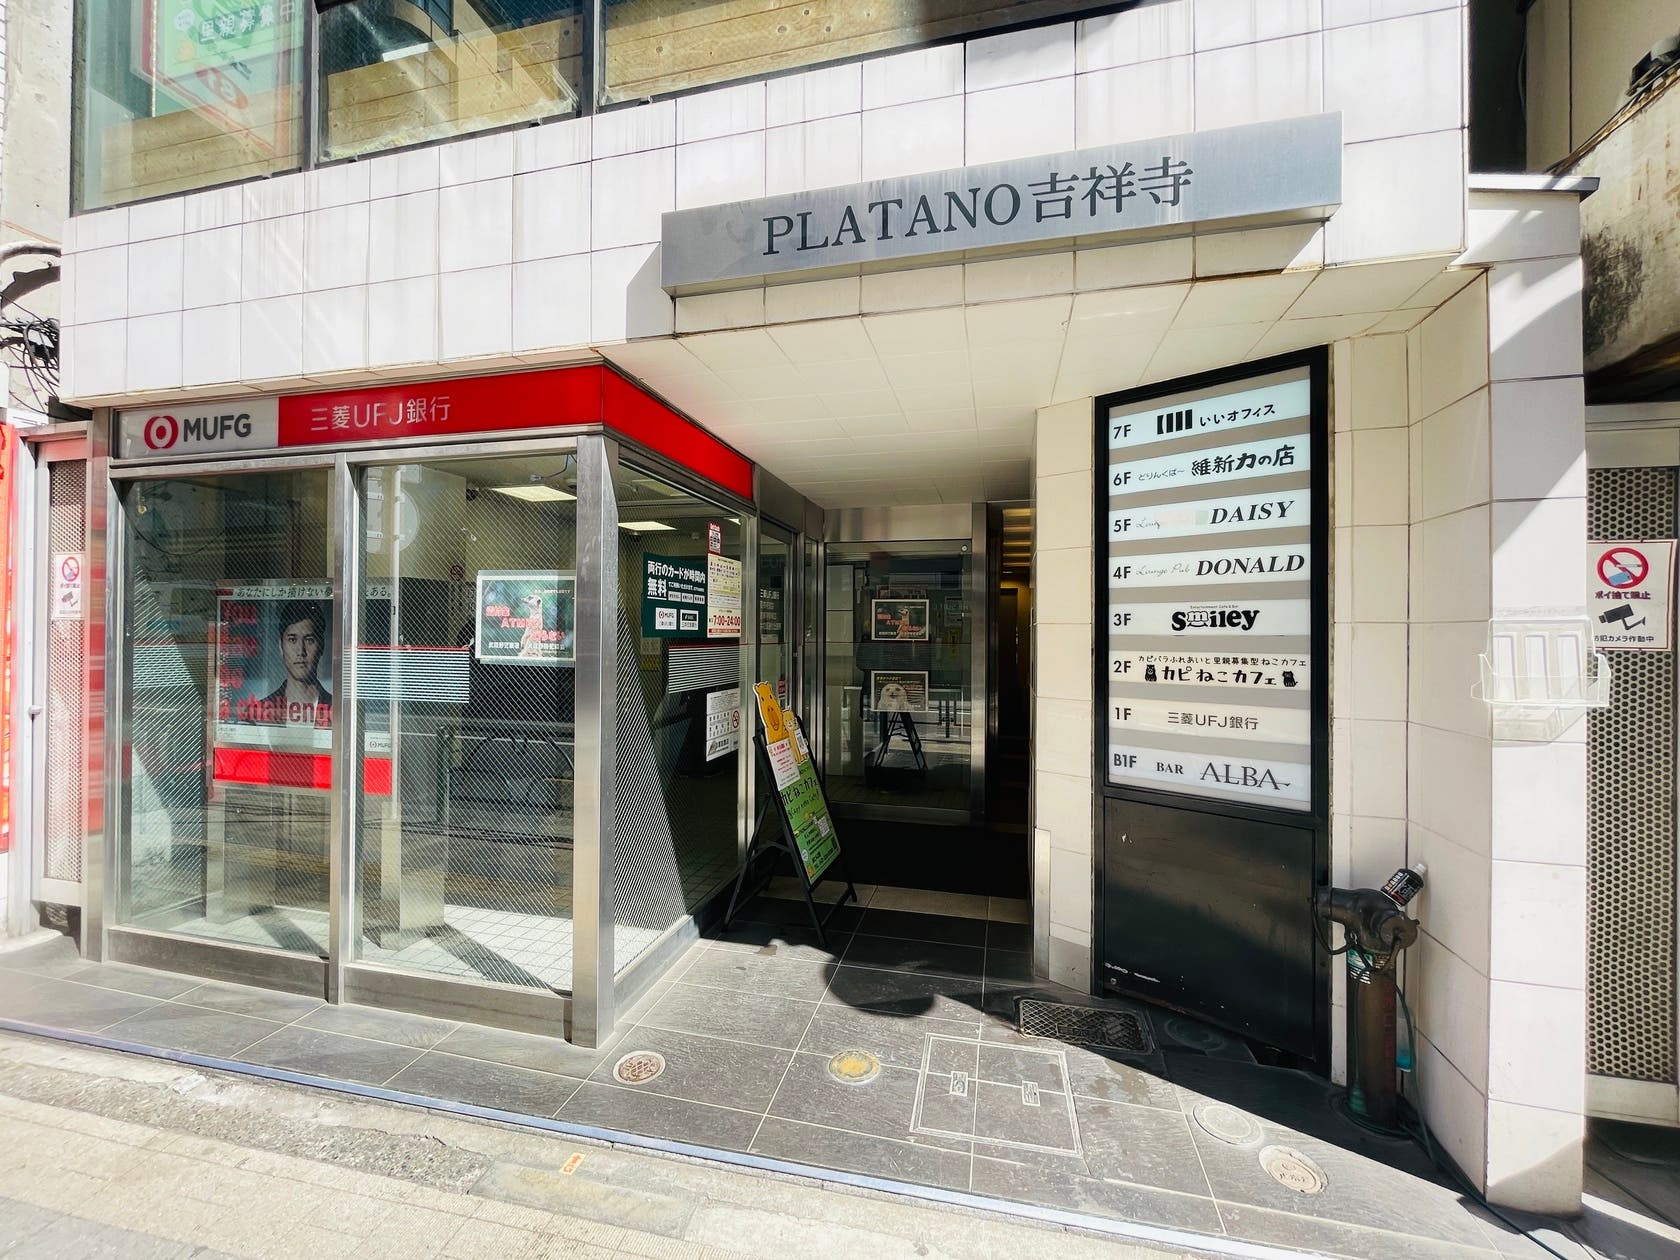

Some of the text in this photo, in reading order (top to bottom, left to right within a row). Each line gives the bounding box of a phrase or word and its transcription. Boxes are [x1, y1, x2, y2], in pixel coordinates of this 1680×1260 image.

[310, 396, 451, 432] 三菱UFJ銀行
[1113, 404, 1276, 439] 7F いいオフィス
[183, 413, 251, 442] MUFG
[1113, 472, 1132, 486] 6F
[1113, 519, 1132, 532] 5F
[1209, 500, 1295, 525] DAISY
[1113, 566, 1132, 579] 4F
[1196, 554, 1304, 576] DONALD
[647, 577, 667, 597] 無料
[1595, 591, 1652, 600] ポイ捨て禁止
[1113, 613, 1132, 626] 3F
[1113, 661, 1277, 686] 2F カピねこカフェ
[1114, 707, 1258, 730] 1F 三菱UFJ銀行
[1113, 753, 1287, 790] B1F BAR ALBA
